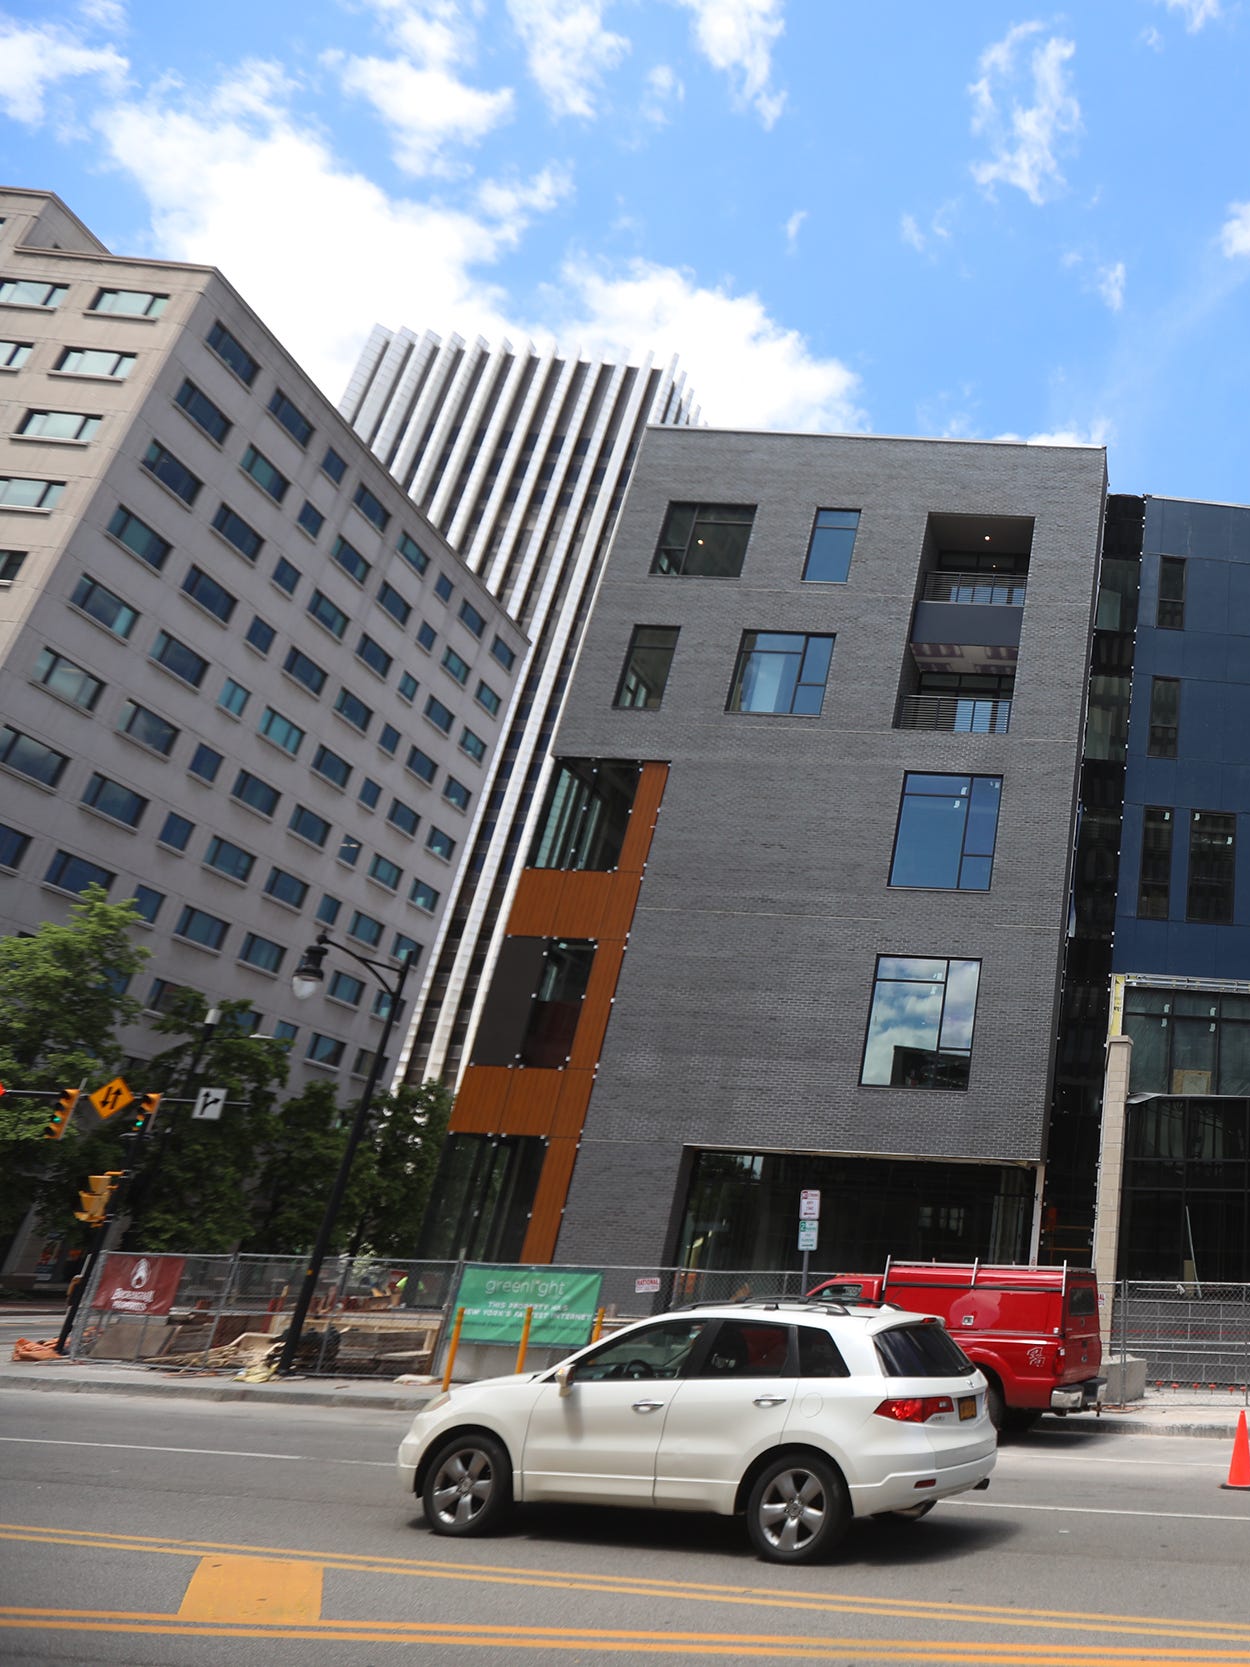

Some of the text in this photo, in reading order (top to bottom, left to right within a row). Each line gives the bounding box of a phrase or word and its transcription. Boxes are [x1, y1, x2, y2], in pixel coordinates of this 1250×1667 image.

[488, 1301, 506, 1309] THIS
[508, 1302, 548, 1311] PROPERTY
[483, 1309, 512, 1318] YORK'S
[513, 1310, 549, 1319] FATEST
